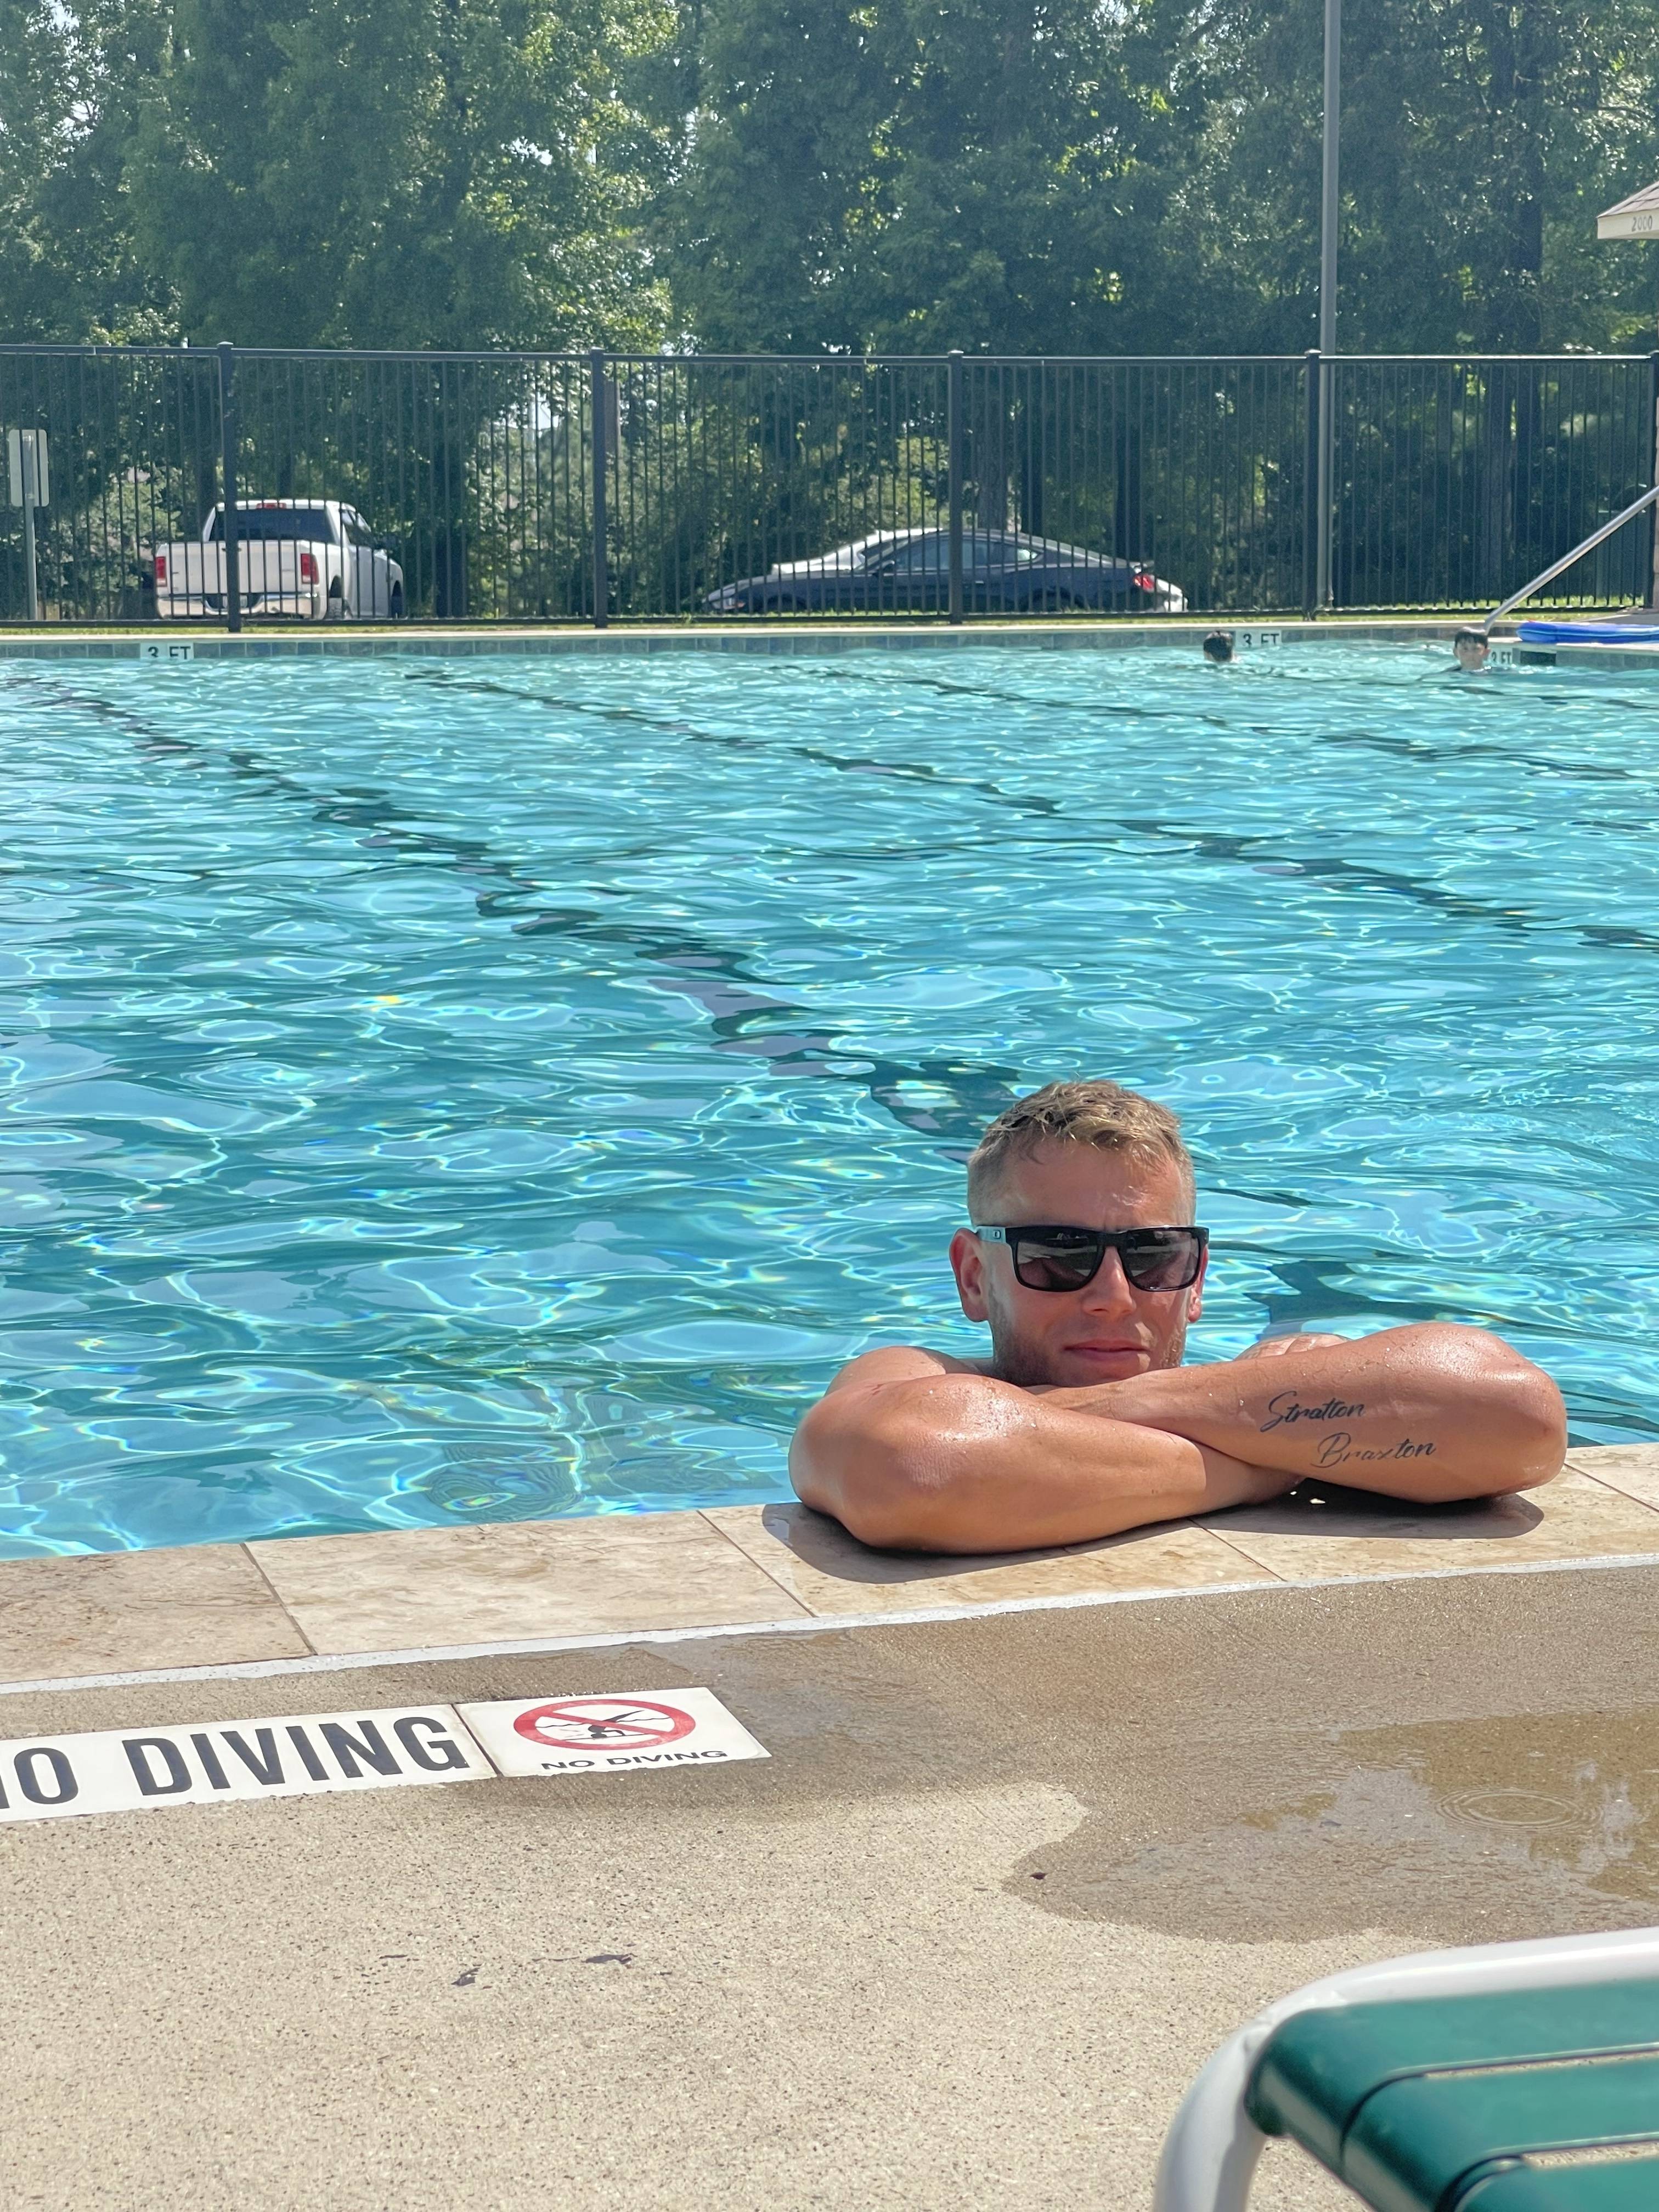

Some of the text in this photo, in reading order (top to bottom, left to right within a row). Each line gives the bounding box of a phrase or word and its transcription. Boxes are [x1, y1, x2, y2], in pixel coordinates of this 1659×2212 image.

[148, 646, 191, 659] 3 FT
[1242, 633, 1280, 646] 3 FT
[1260, 1390, 1368, 1432] Stratton
[1310, 1432, 1437, 1469] Braxton
[0, 1717, 470, 1809] O DIVING
[541, 1751, 729, 1770] NO DIVING
